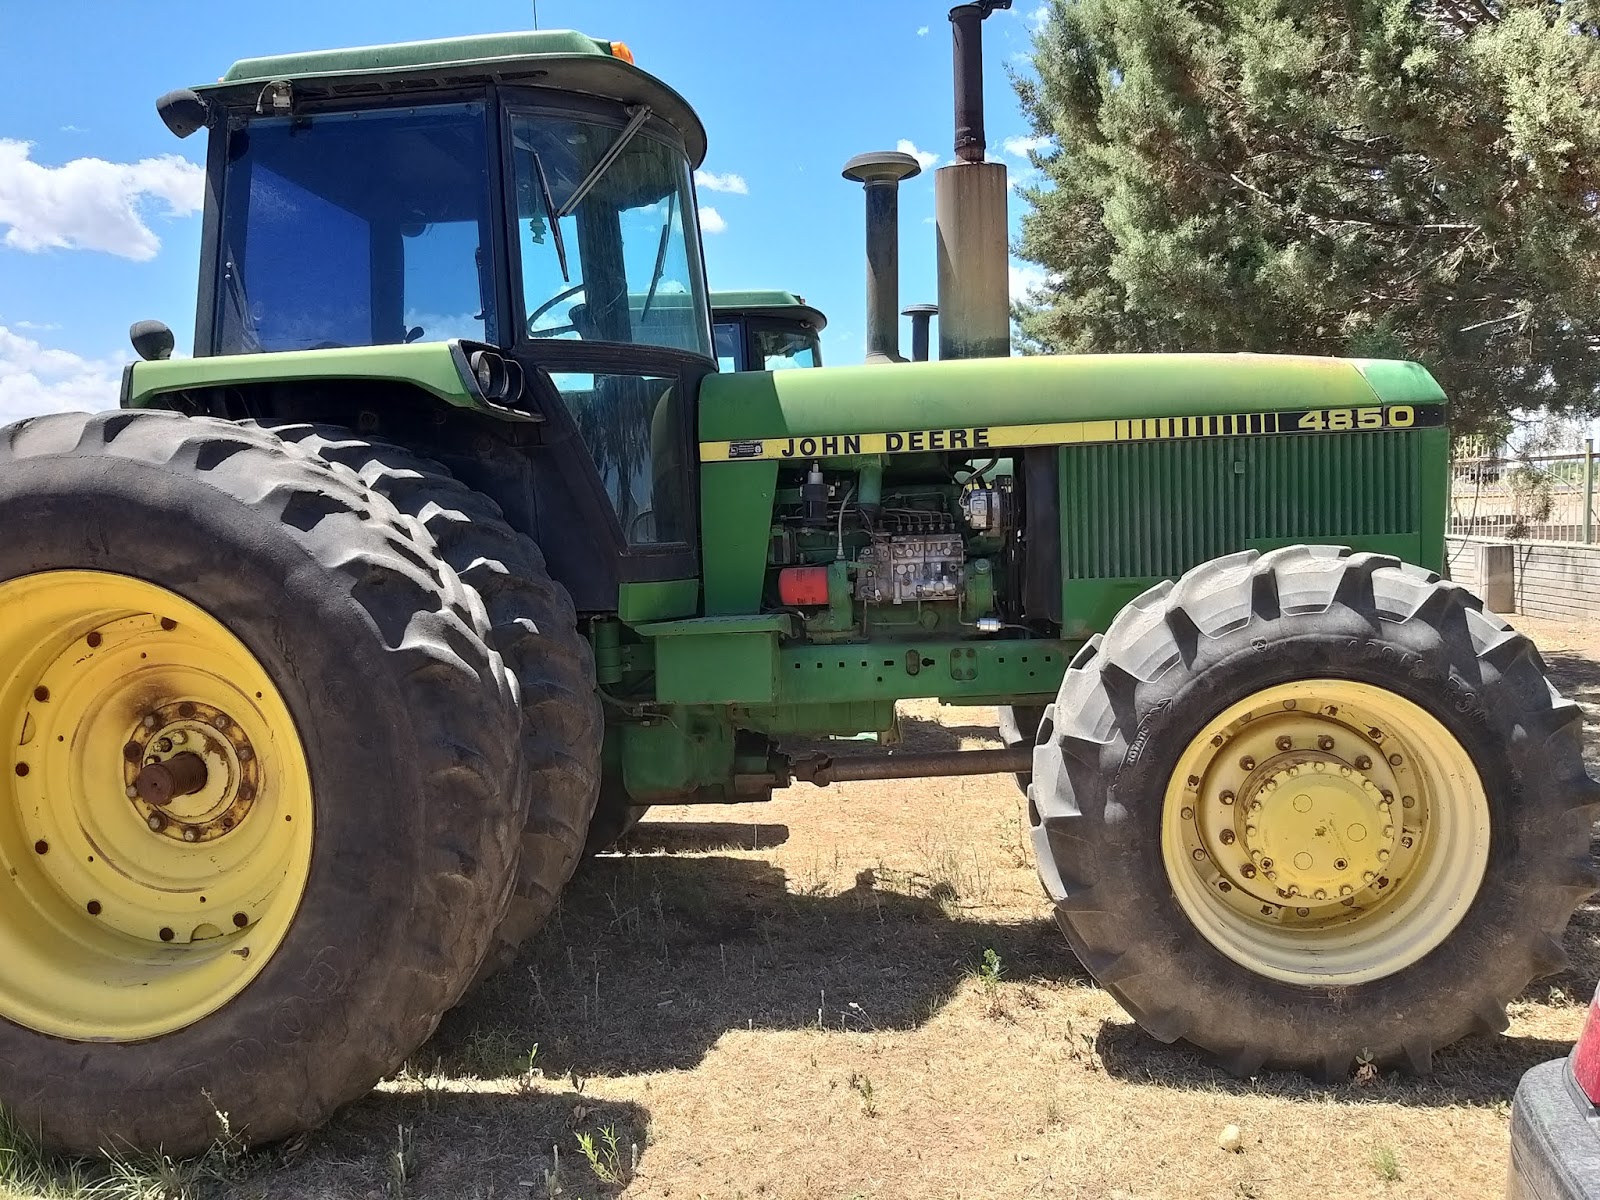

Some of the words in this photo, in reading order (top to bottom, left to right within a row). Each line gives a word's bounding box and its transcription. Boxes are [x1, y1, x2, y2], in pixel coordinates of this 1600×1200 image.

[1299, 405, 1414, 430] 4850
[783, 436, 860, 457] JOHN
[887, 429, 989, 452] DEERE
